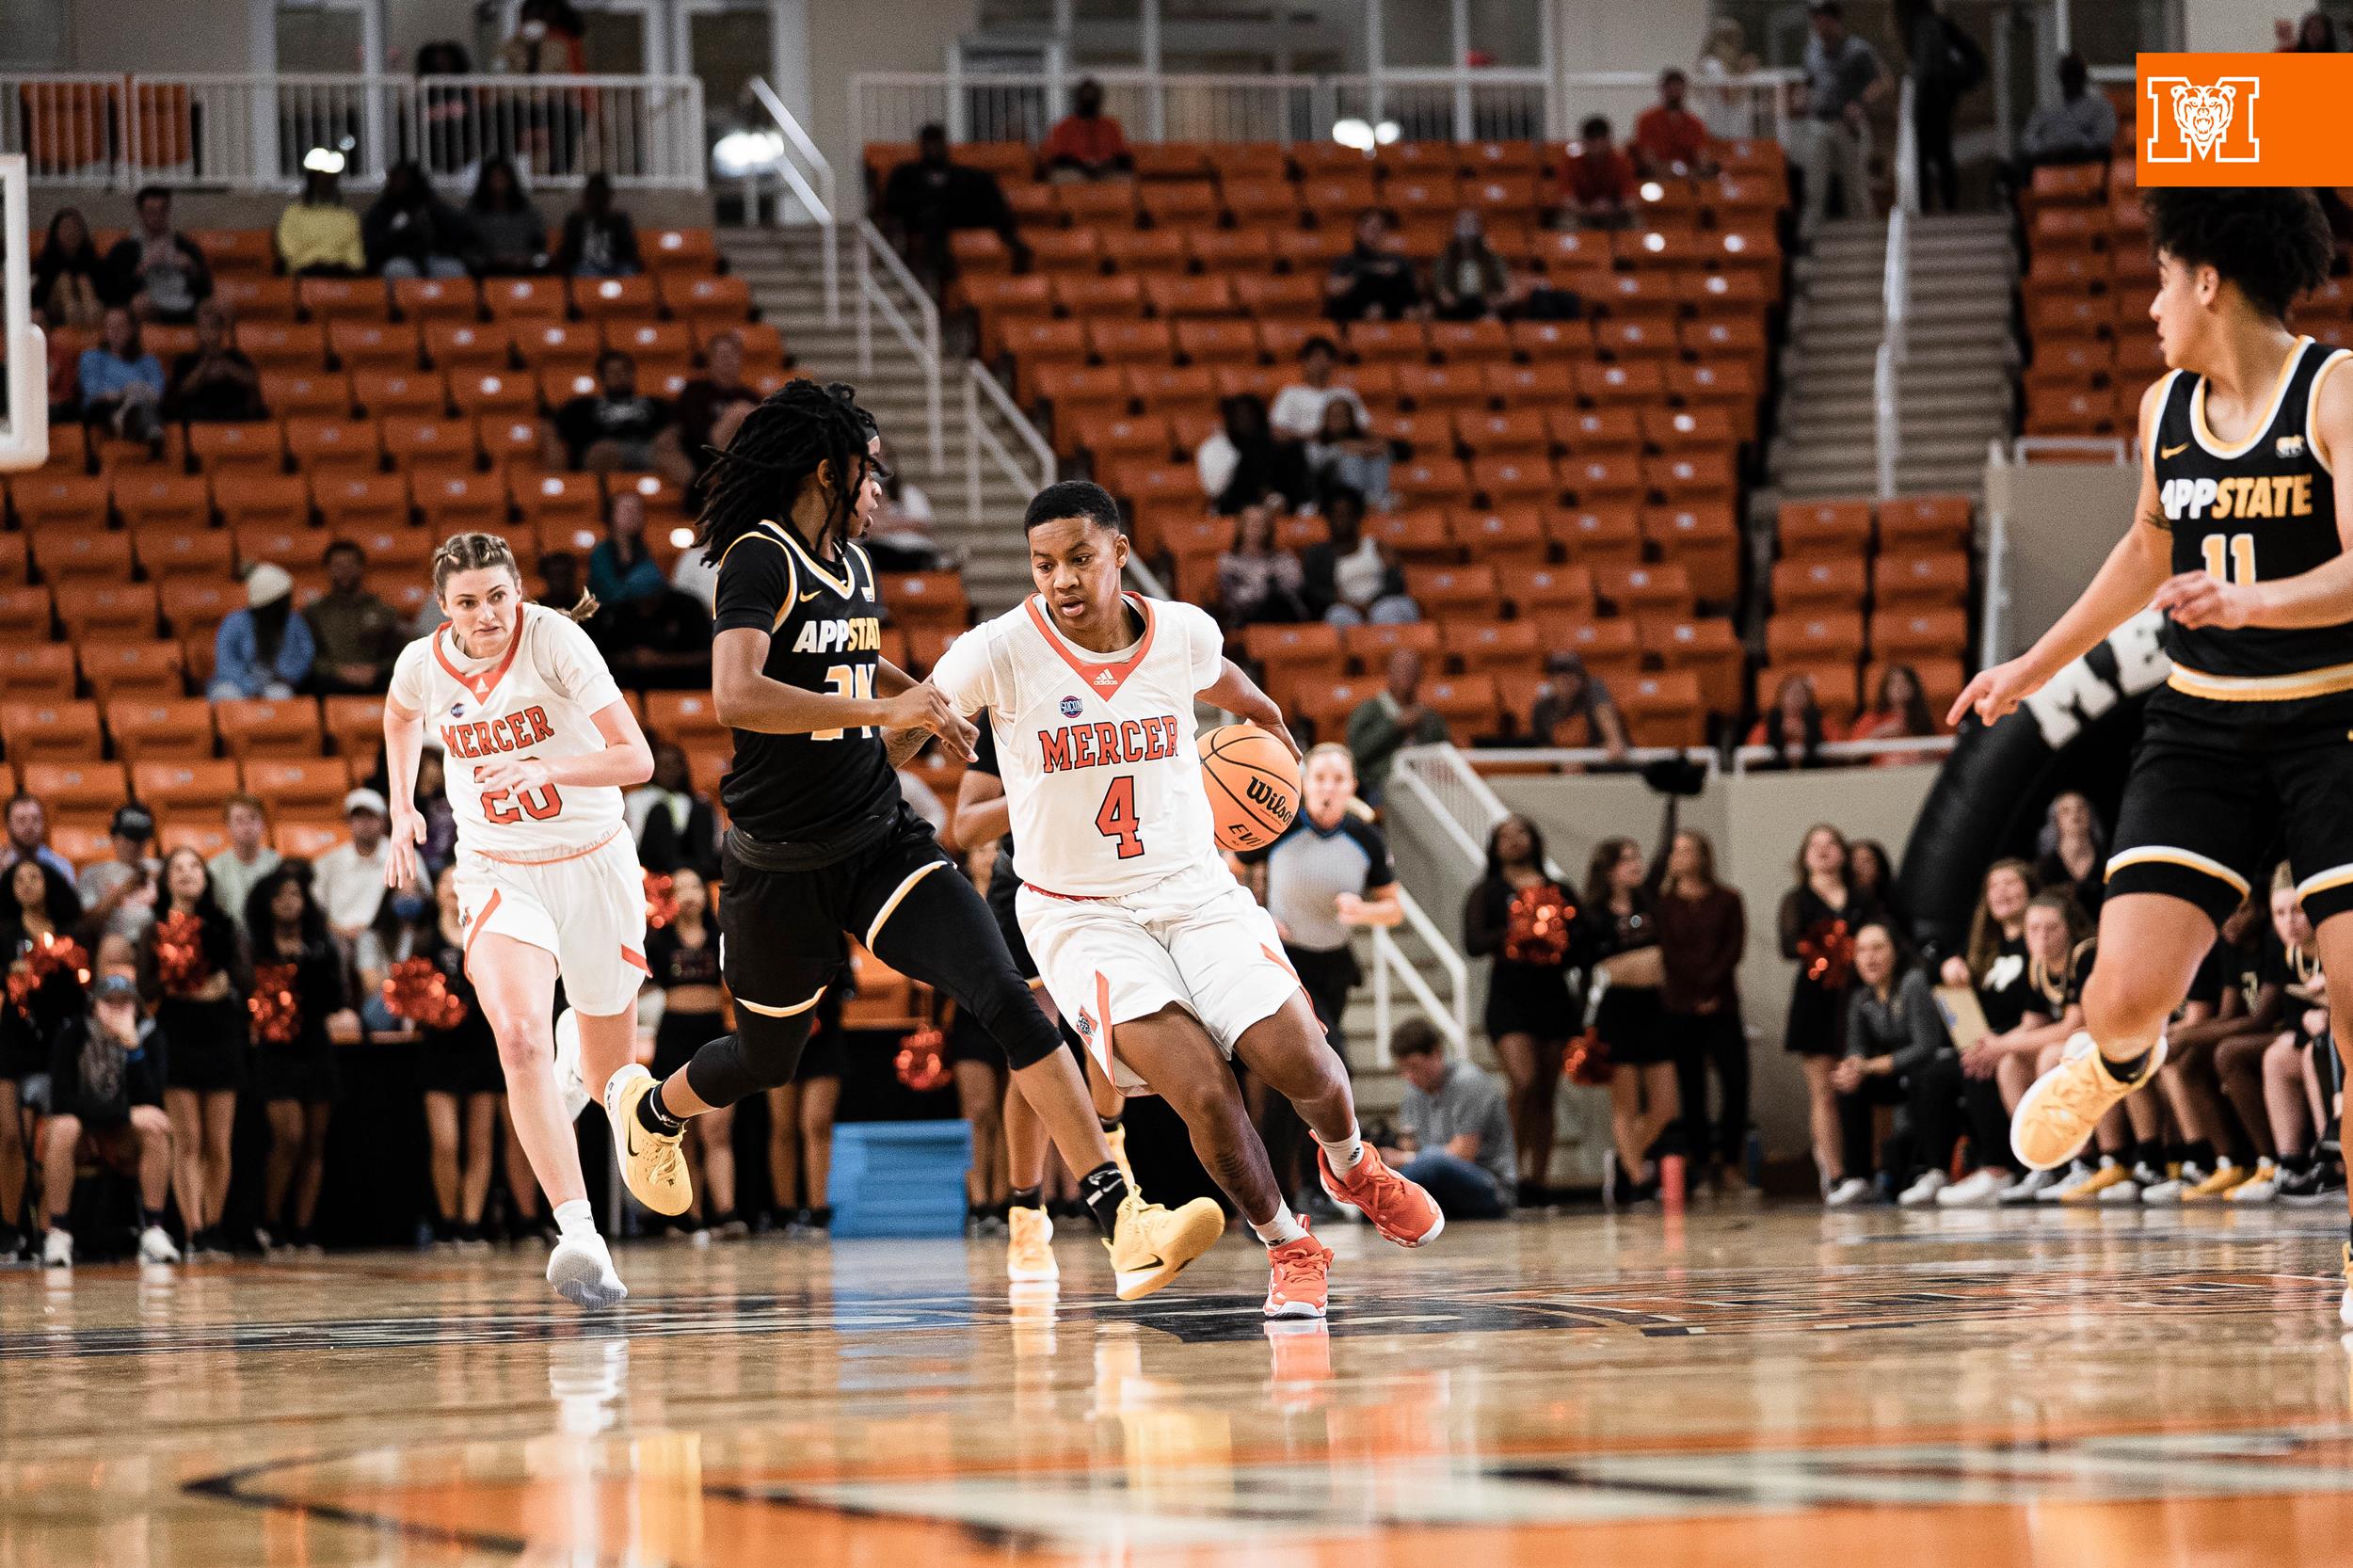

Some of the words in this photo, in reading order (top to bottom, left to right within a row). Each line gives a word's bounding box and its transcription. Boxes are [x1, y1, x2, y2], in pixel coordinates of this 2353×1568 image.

[2201, 533, 2256, 585] 11
[440, 706, 555, 759] MERCER
[1038, 715, 1178, 774] MERCER
[1095, 776, 1144, 859] 4
[1246, 776, 1293, 825] Wilso
